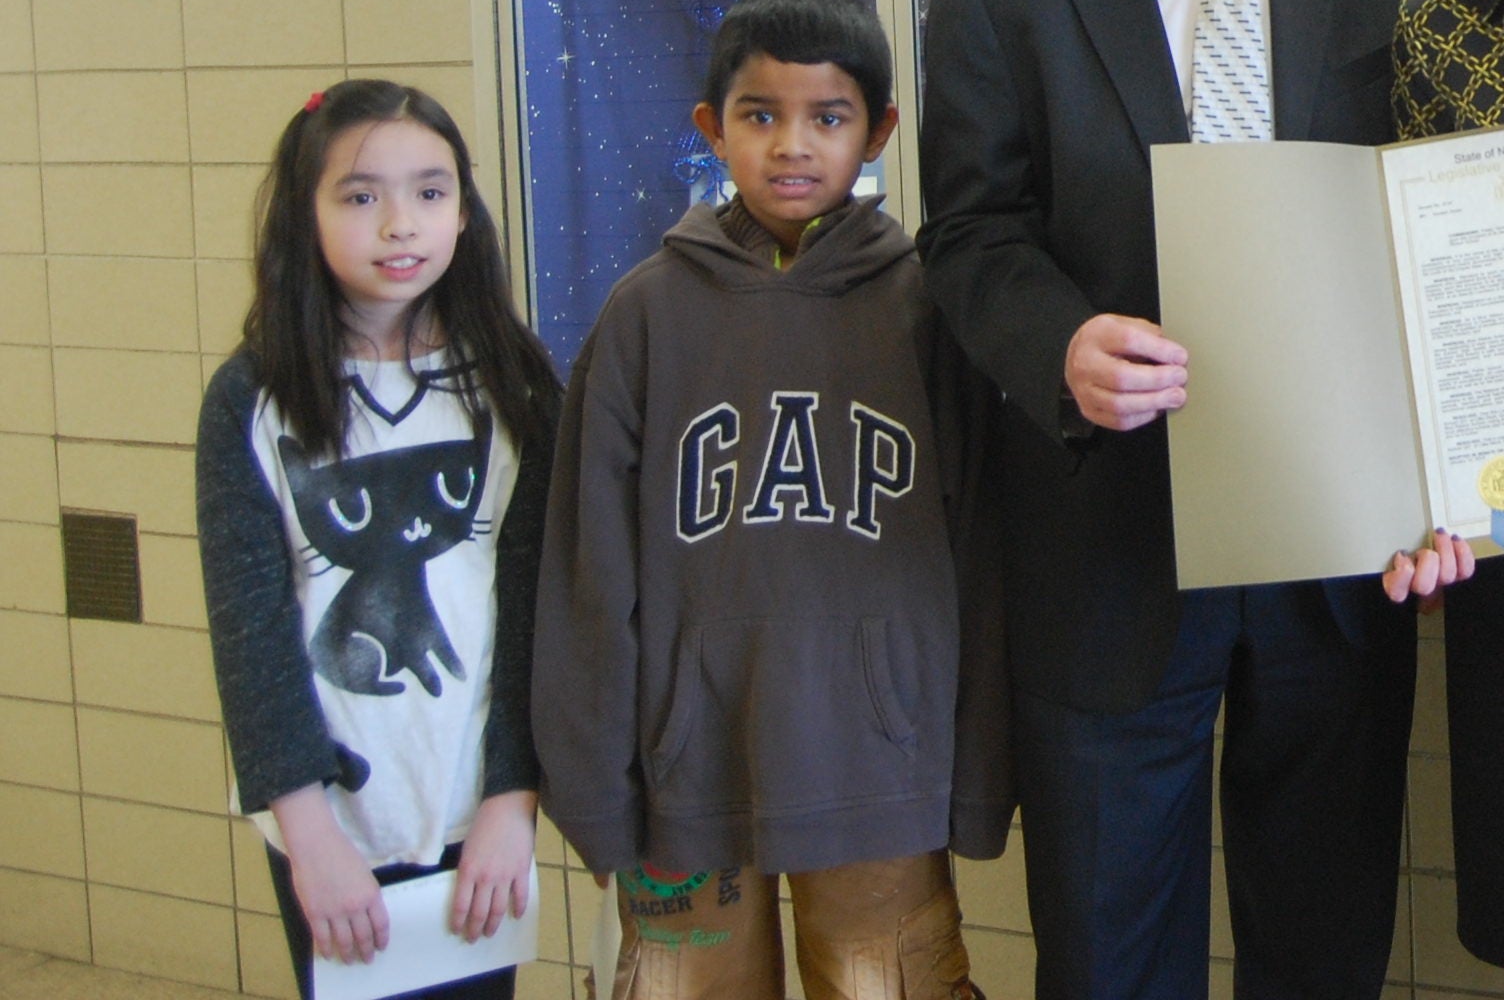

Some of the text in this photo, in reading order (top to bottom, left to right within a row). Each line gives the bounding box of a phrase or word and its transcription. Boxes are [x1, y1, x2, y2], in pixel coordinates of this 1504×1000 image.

[1454, 151, 1482, 165] State
[1484, 148, 1495, 160] of
[1428, 163, 1501, 184] Legislative
[676, 391, 916, 544] GAP
